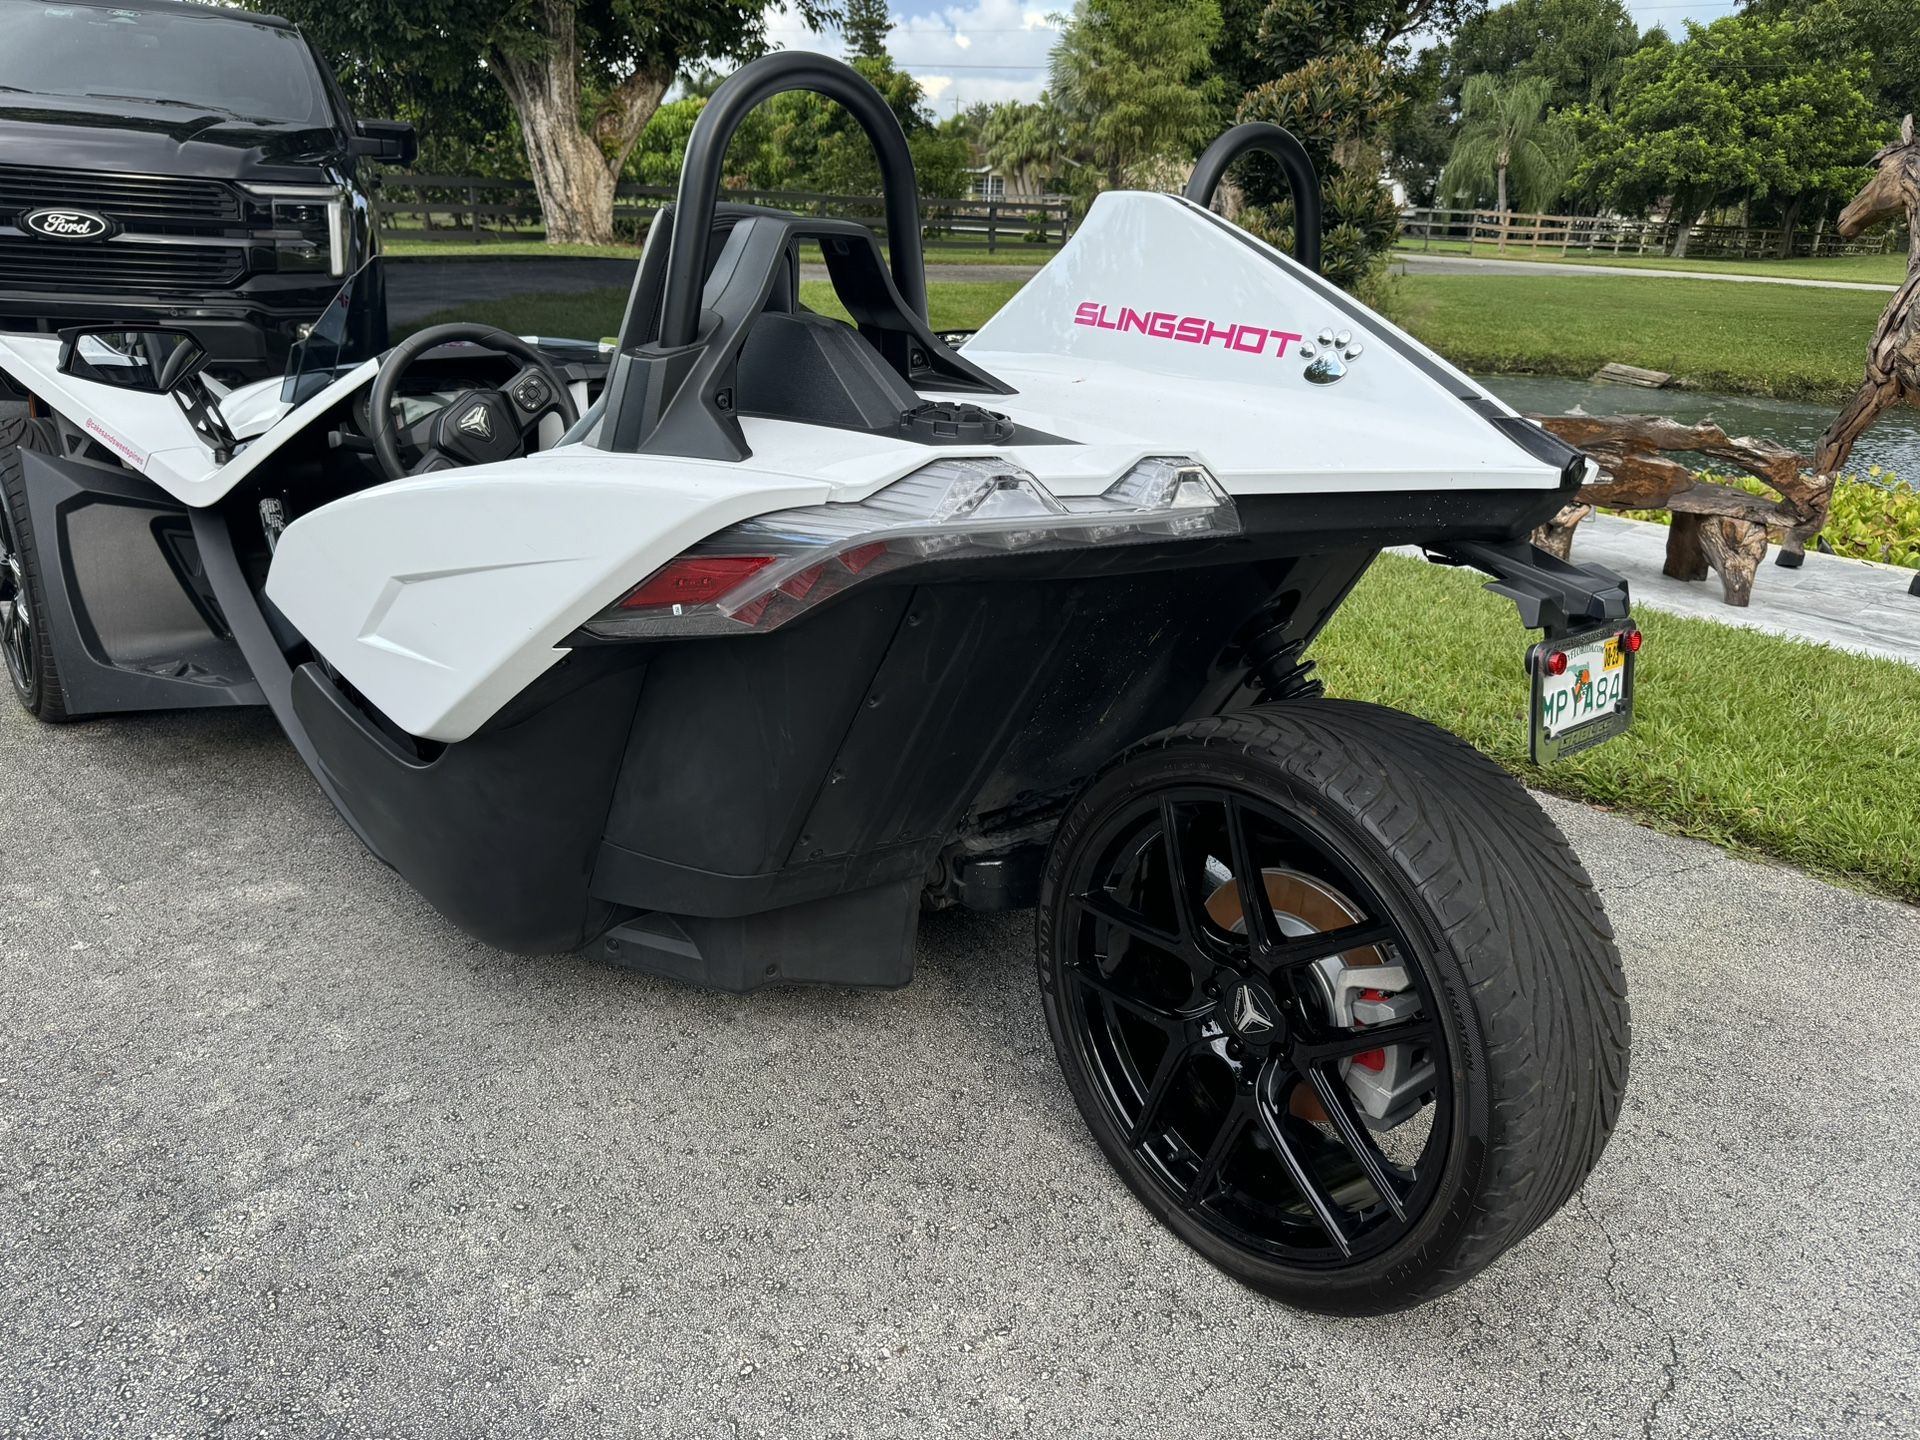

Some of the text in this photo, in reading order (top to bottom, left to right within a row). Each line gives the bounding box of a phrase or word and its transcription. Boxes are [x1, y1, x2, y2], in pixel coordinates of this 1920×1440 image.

[43, 213, 91, 234] Ford
[1074, 301, 1303, 358] SLINGSHOT
[1542, 672, 1620, 725] MPYA84
[1447, 986, 1475, 1071] ROTATION
